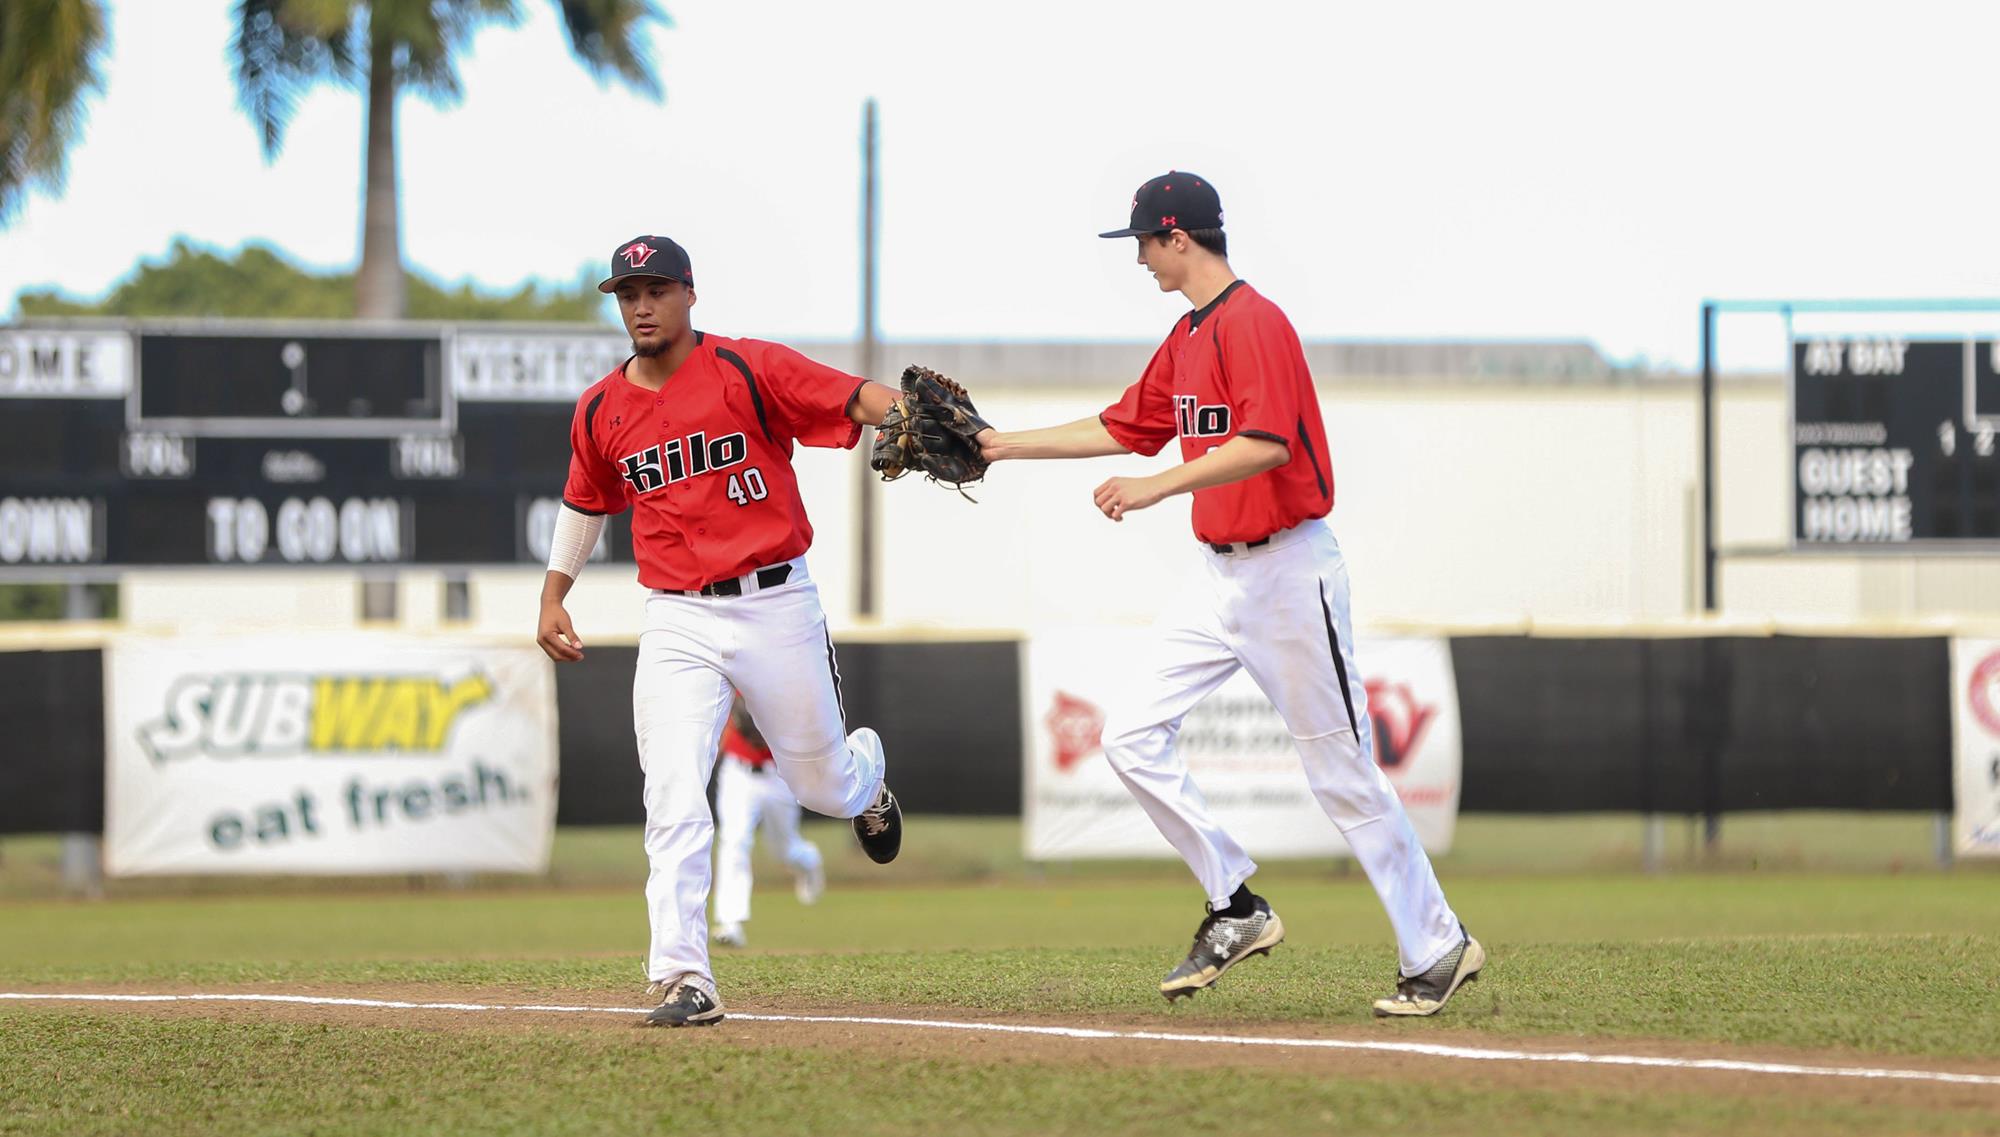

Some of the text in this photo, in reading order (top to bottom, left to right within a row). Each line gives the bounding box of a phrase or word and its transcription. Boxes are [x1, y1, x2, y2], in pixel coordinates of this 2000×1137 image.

[1804, 340, 1908, 374] AT BAT
[1172, 394, 1231, 438] ilo
[1936, 420, 1996, 456] 1 2
[618, 430, 747, 494] Hilo
[1801, 449, 1912, 497] GUEST
[727, 466, 769, 506] 40
[206, 497, 270, 562] TO
[1803, 498, 1911, 541] HOME
[138, 671, 493, 766] SUBWAY
[208, 790, 317, 849] eat
